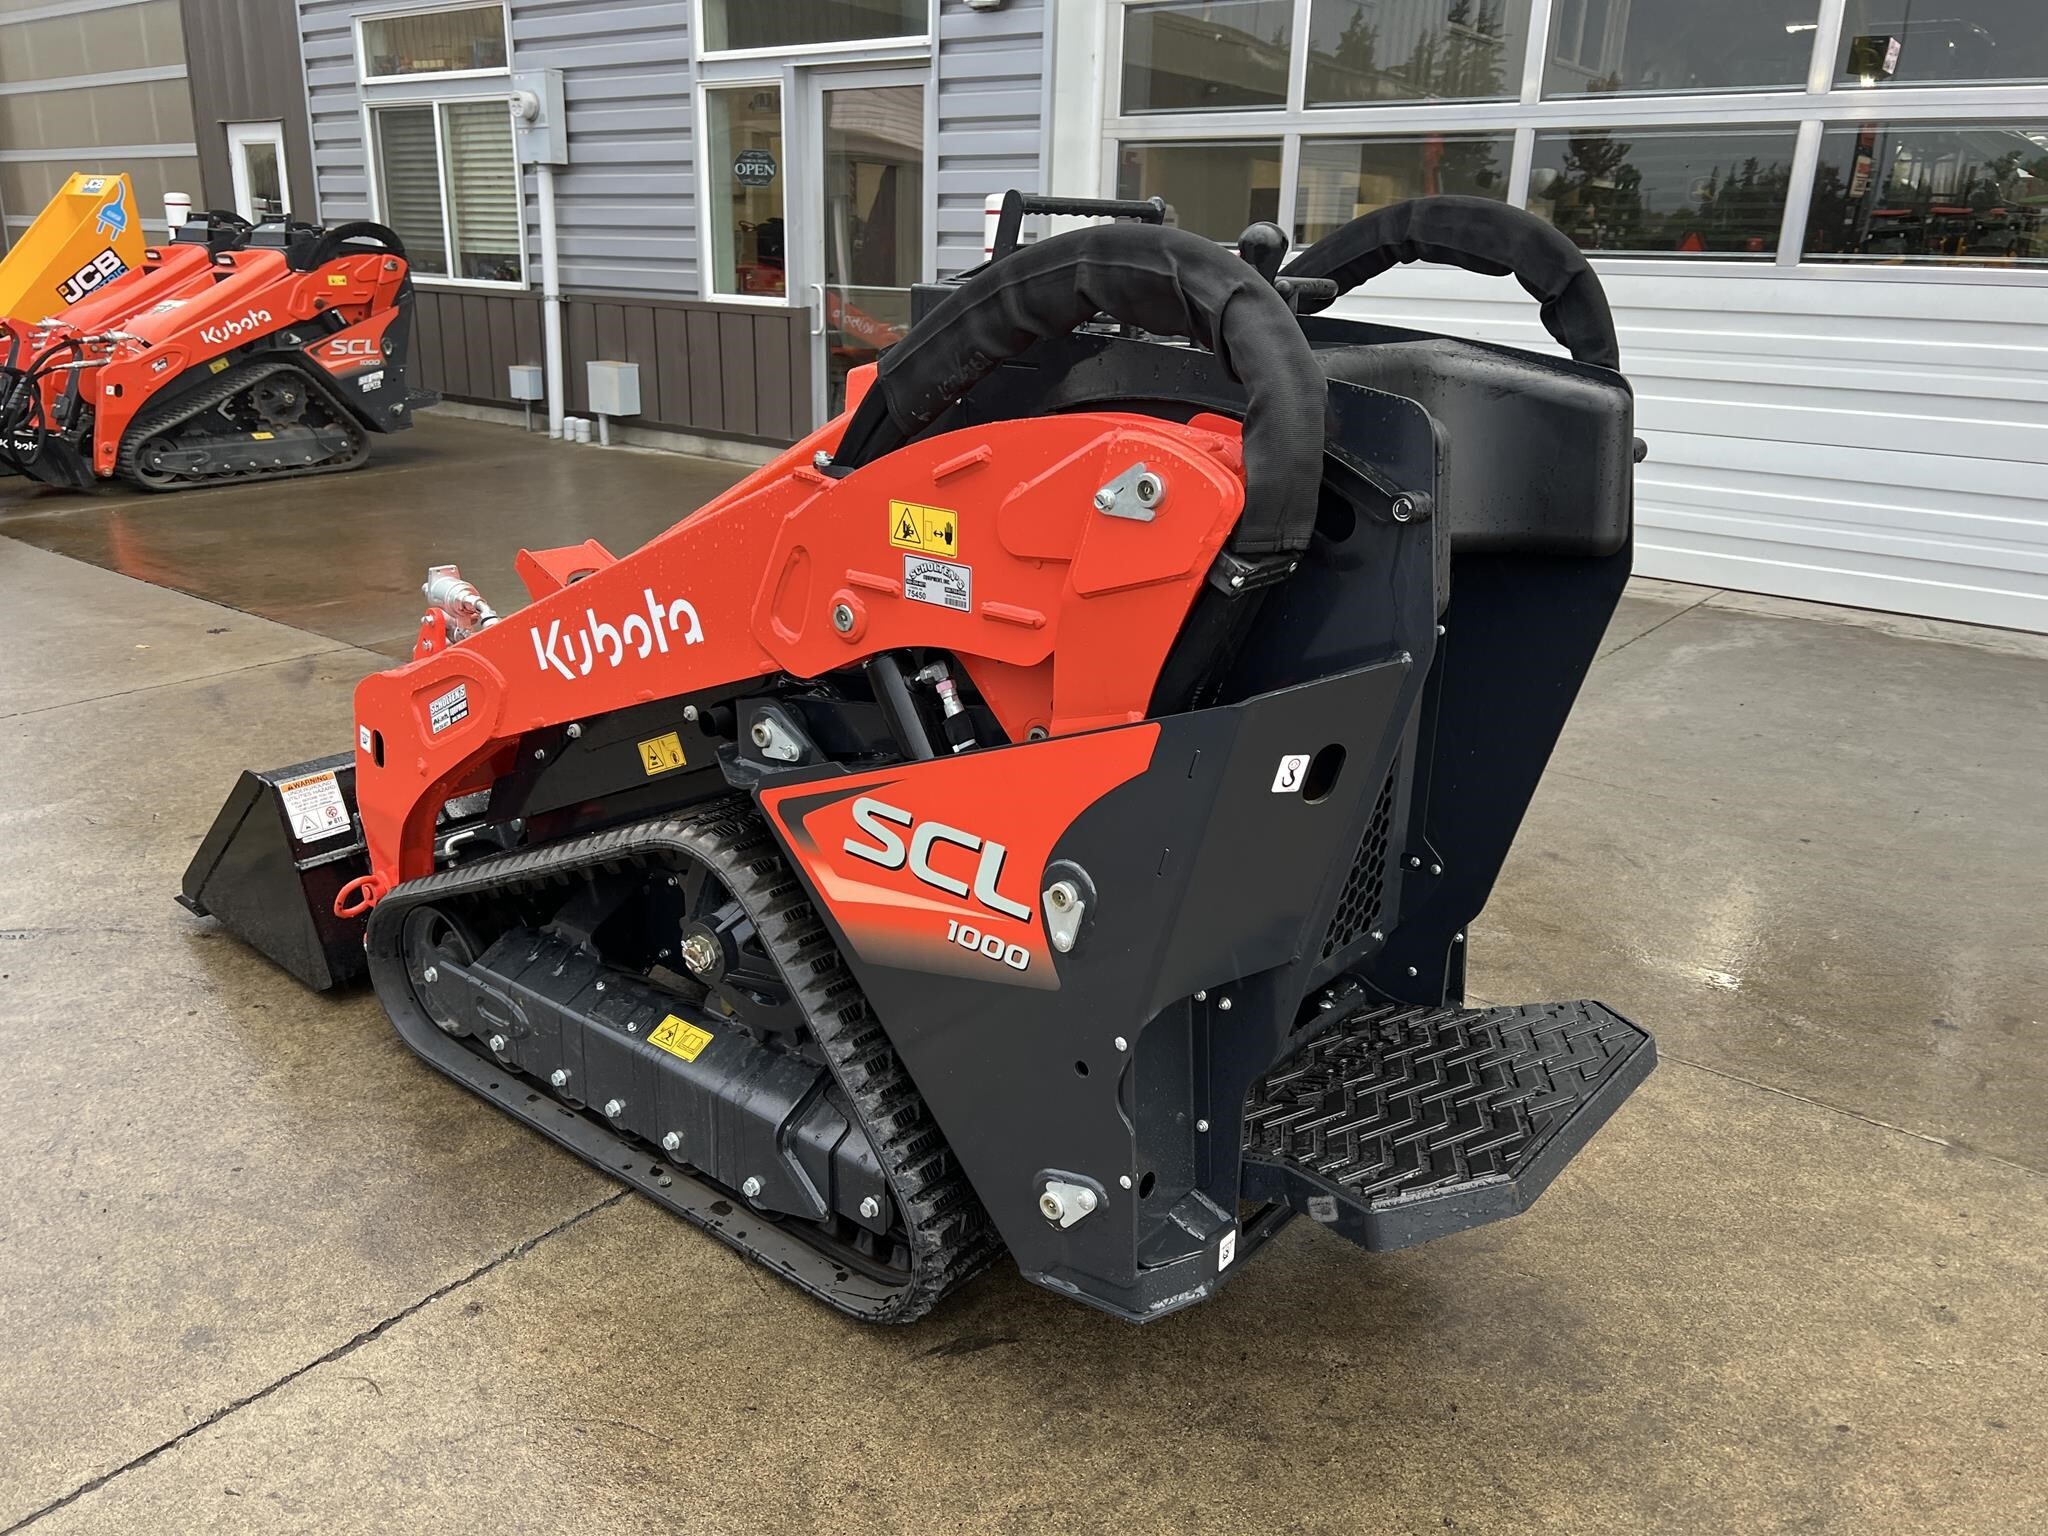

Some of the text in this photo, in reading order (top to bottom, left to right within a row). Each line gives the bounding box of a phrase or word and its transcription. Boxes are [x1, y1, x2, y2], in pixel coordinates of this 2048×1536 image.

[734, 163, 776, 176] OPEN
[64, 249, 122, 304] JCB
[200, 309, 272, 344] Kubota
[329, 339, 380, 355] SCL
[908, 562, 966, 591] SCHOLTEN'S
[907, 589, 927, 600] 75450
[530, 588, 705, 680] Kubota
[293, 774, 329, 789] WARNING
[843, 797, 1033, 923] SCL
[947, 919, 1031, 971] 1000
